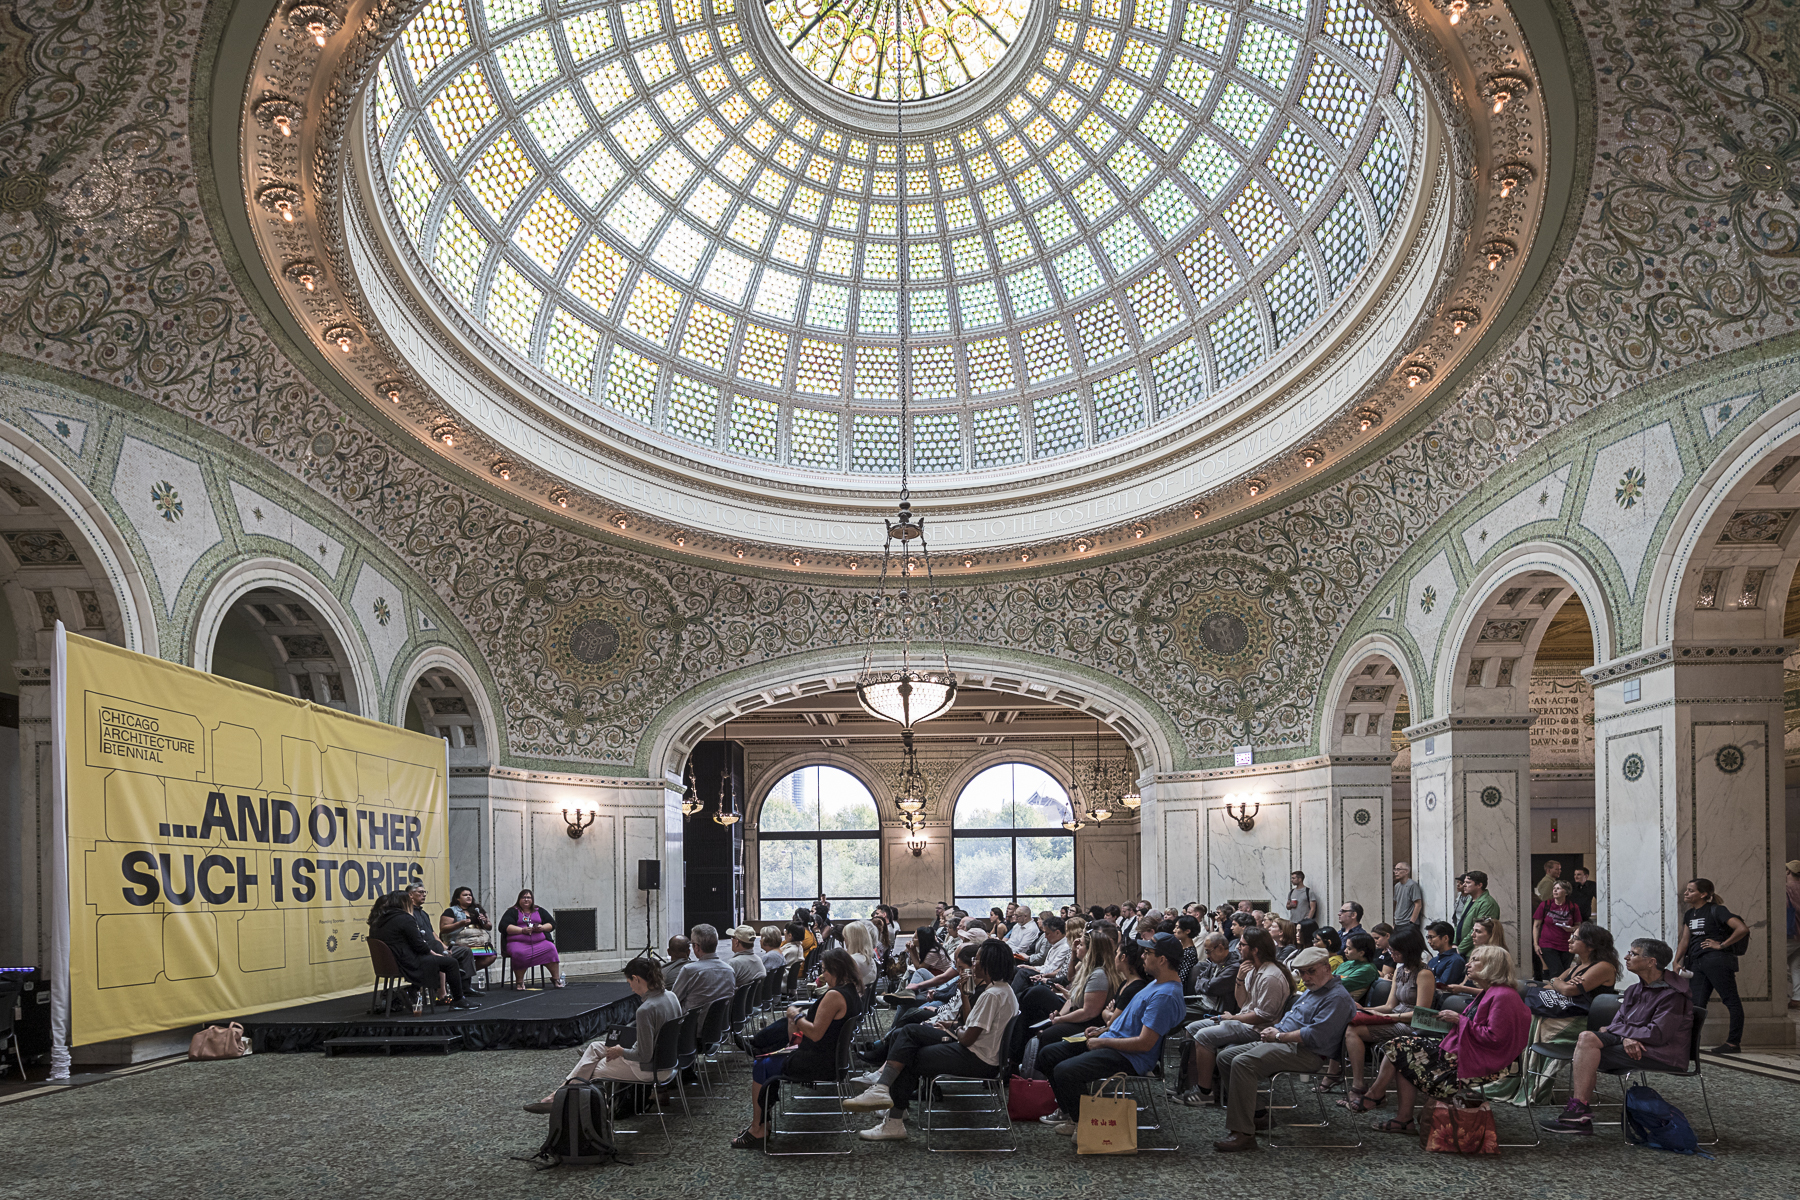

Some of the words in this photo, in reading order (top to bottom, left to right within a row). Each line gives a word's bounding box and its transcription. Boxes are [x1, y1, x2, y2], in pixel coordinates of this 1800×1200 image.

[365, 264, 386, 317] ARE
[389, 304, 475, 408] DELIVERED
[479, 396, 533, 450] DOWN
[537, 436, 588, 479] FROM
[593, 466, 708, 519] GENERATION
[712, 505, 738, 526] TO
[863, 526, 885, 542] AS
[910, 522, 977, 542] SENTS
[983, 520, 1006, 536] TO
[1012, 514, 1044, 534] THE
[1050, 486, 1145, 527] POSTERITY
[1149, 475, 1175, 499] OF
[1181, 447, 1237, 488] THOSE
[1242, 420, 1284, 457] WHO
[1287, 396, 1319, 434] ARE
[1323, 363, 1354, 398] YET
[1356, 289, 1413, 375] VNBORN
[101, 710, 159, 732] CHICAGO
[103, 726, 195, 754] ARCHITECTURE
[103, 742, 163, 763] BIENNIAL
[121, 850, 284, 907] SUCH
[291, 857, 424, 903] STORIES
